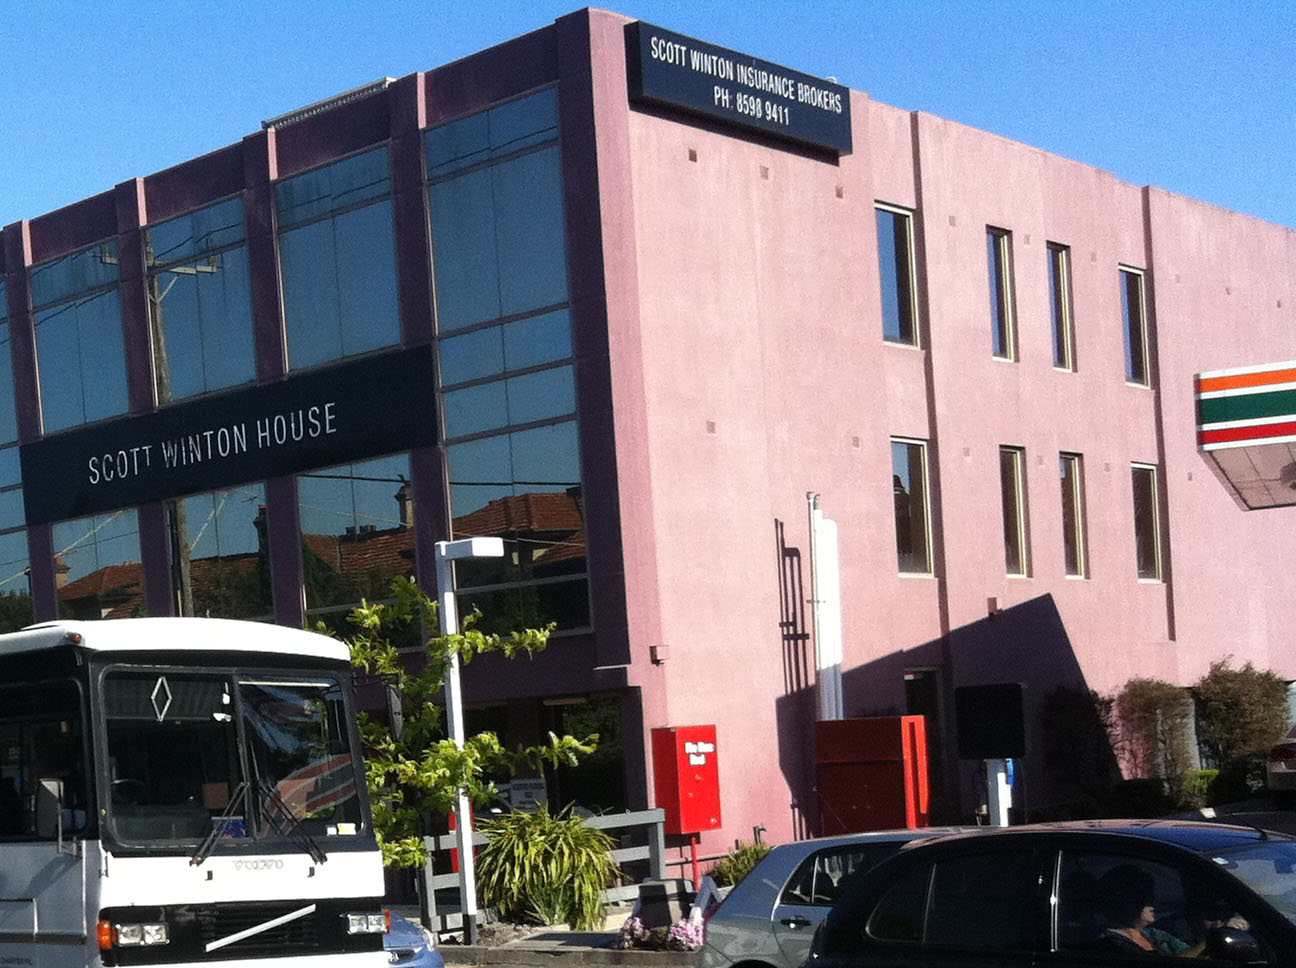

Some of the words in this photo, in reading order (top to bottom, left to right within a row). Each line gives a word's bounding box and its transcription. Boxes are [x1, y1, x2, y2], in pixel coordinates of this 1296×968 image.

[651, 36, 687, 66] SCOTT
[690, 50, 734, 81] WINTON
[737, 64, 795, 100] INSURANCE
[798, 83, 842, 114] BROKERS
[714, 85, 734, 111] PH:
[765, 101, 790, 125] 9411
[88, 445, 153, 485] SCOTT
[162, 423, 248, 468] WINTON
[257, 402, 338, 448] HOUSE
